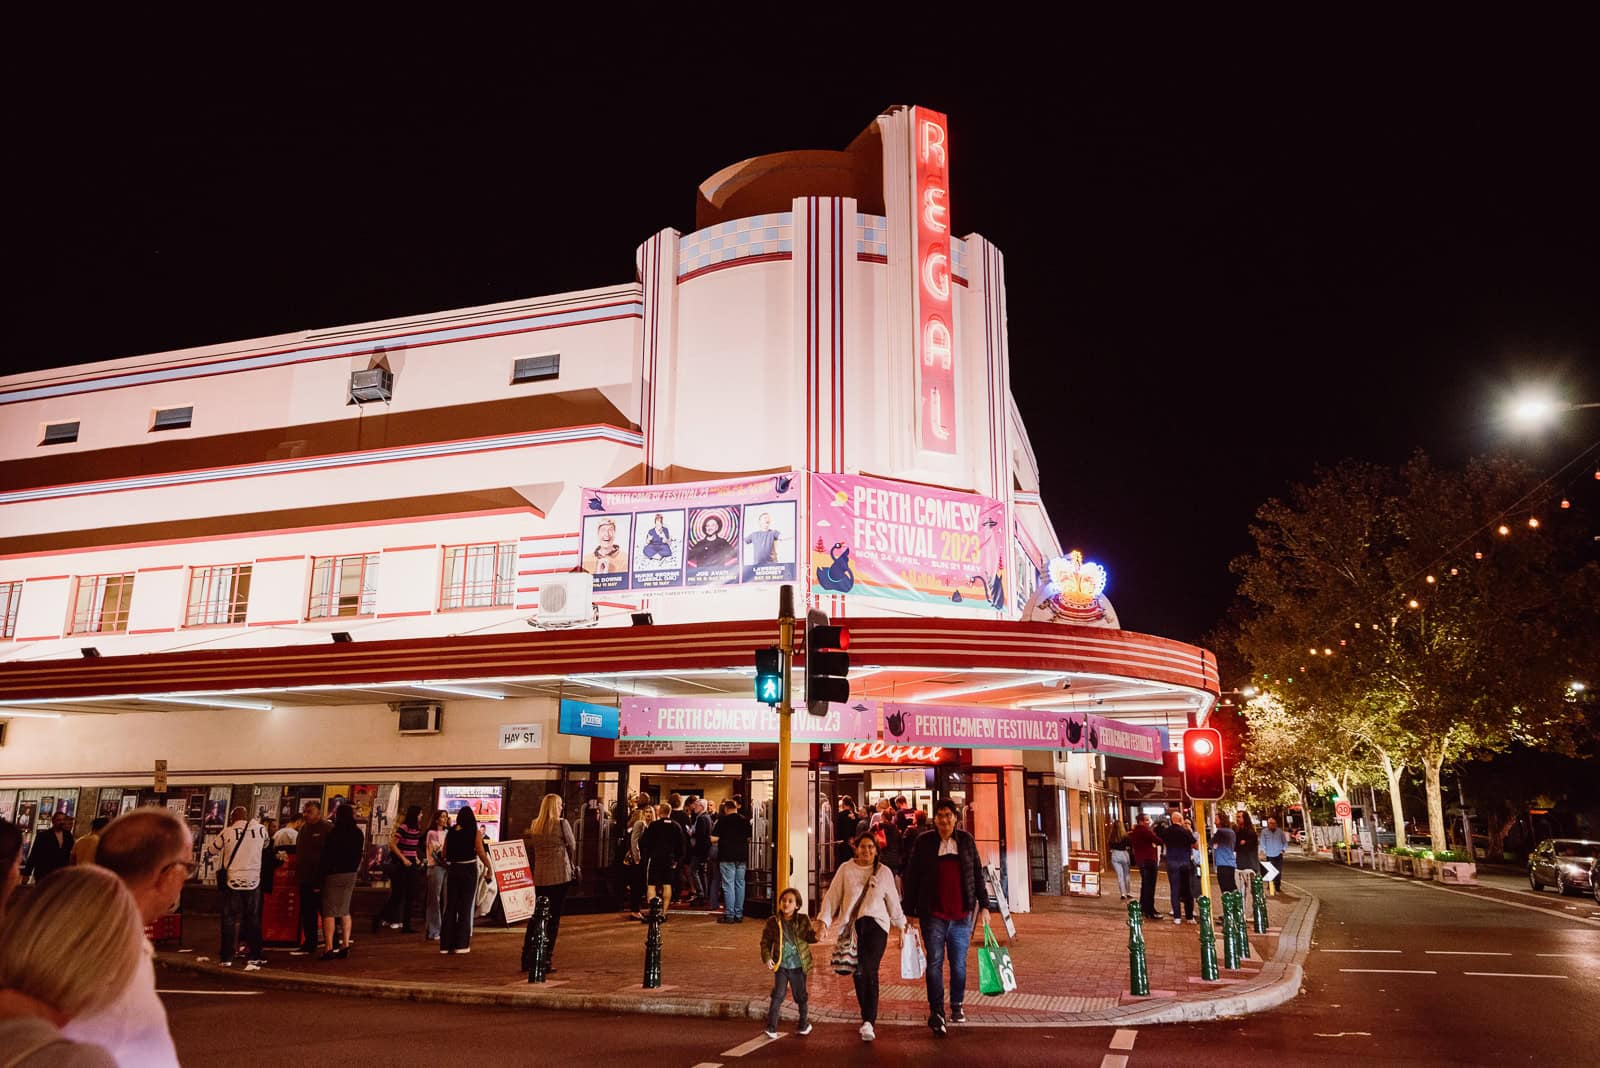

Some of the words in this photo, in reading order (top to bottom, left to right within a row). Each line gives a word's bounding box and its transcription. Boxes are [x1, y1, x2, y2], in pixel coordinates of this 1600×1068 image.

[922, 119, 951, 440] REGAL
[854, 487, 911, 524] PERTH
[915, 498, 981, 532] COMEDY
[853, 518, 937, 559] FESTIVAL
[941, 531, 981, 564] 2023
[962, 564, 983, 573] MAY
[657, 708, 702, 729] PERTH
[703, 709, 758, 731] COMEDY
[915, 714, 951, 737] PERTH
[953, 716, 995, 739] COMEDY
[504, 733, 520, 744] HAY
[523, 732, 536, 743] ST.
[492, 845, 525, 861] BARK
[502, 872, 515, 881] 20%
[515, 870, 526, 880] OFF
